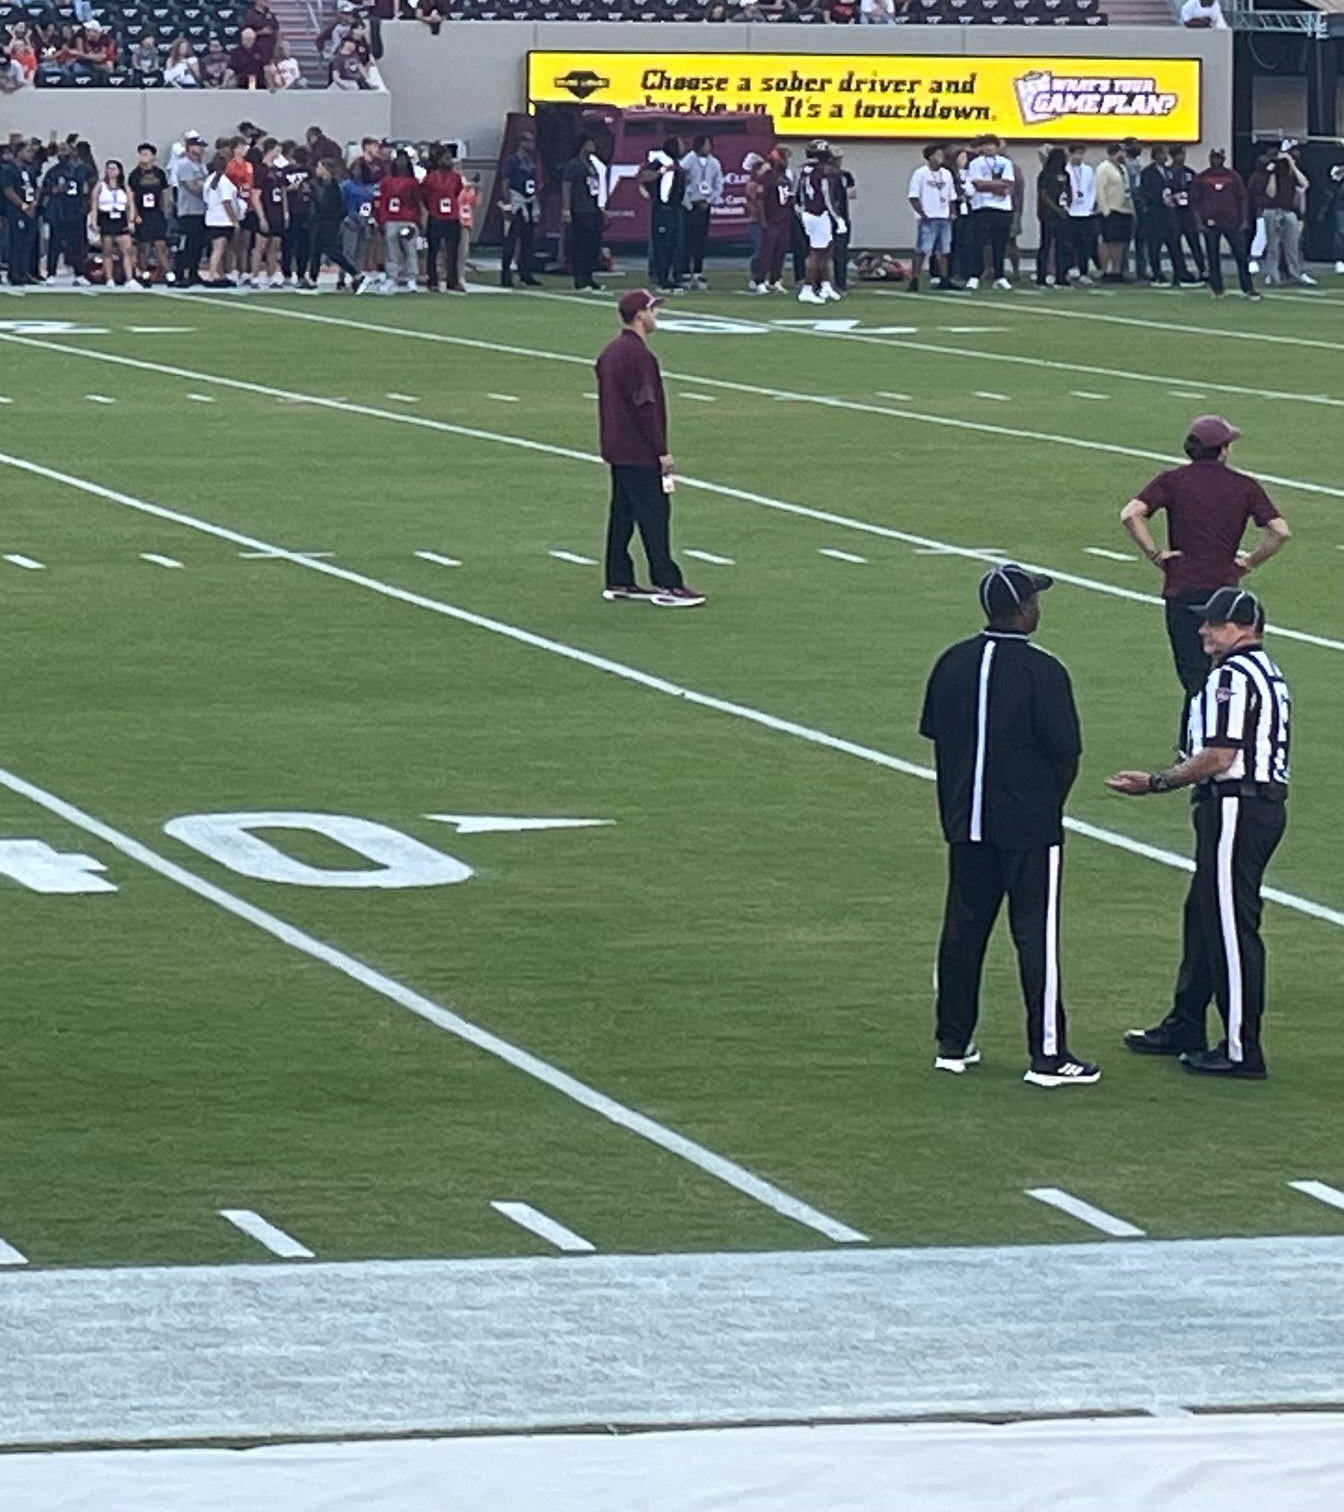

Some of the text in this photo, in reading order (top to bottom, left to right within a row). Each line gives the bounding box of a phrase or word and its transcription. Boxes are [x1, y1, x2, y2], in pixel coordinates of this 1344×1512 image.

[640, 69, 977, 94] Choose a sober driver and
[781, 96, 822, 119] It's
[828, 103, 844, 119] a
[853, 98, 998, 122] touchdown.
[1033, 93, 1176, 114] GAME PLAN?
